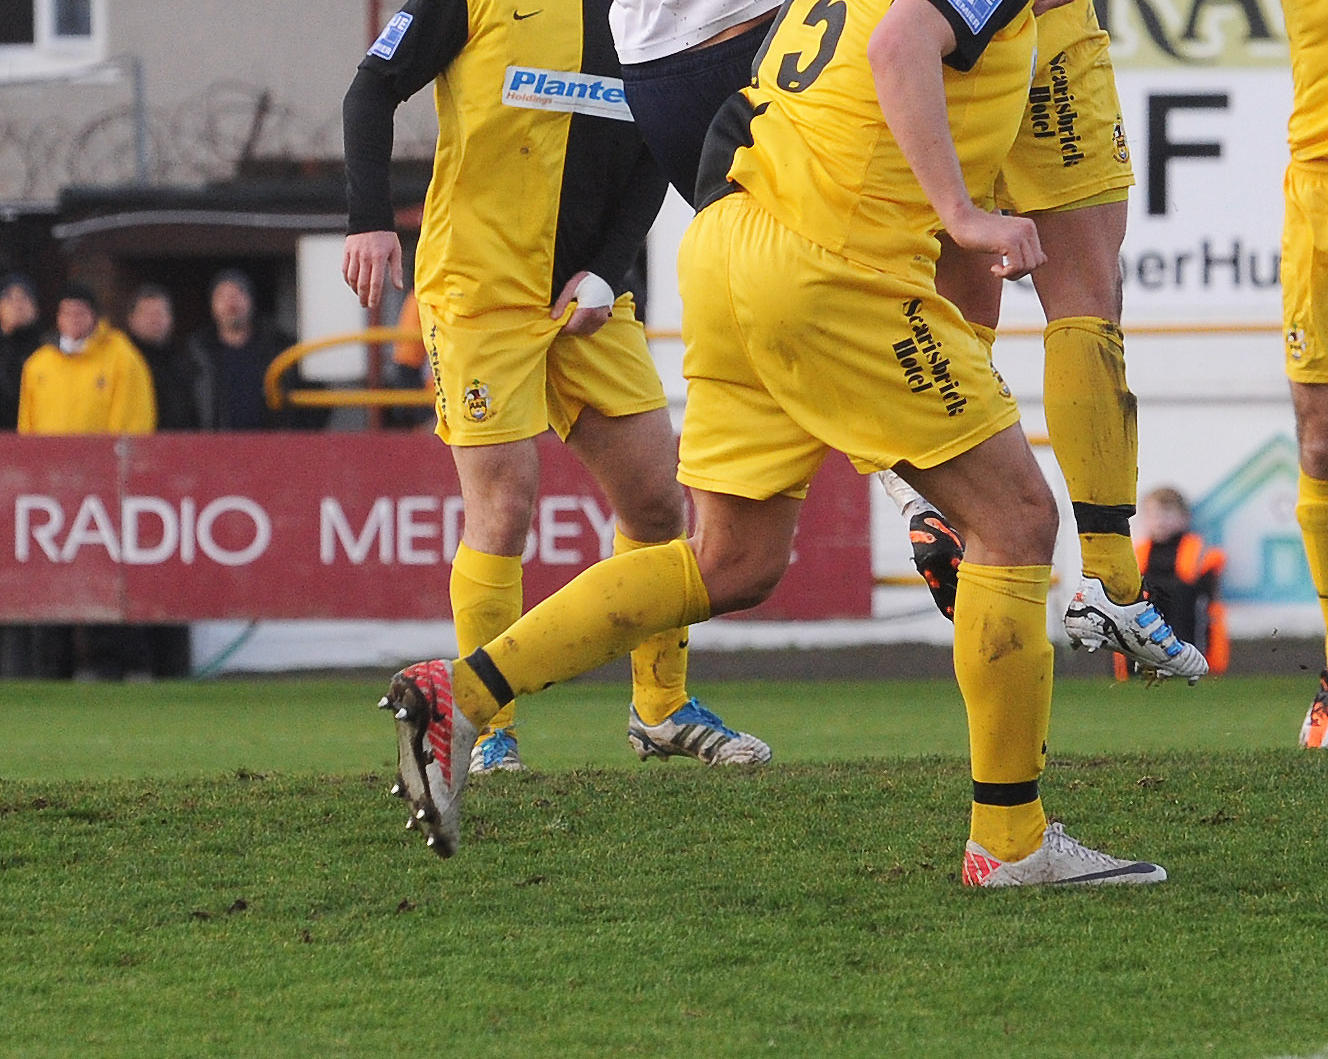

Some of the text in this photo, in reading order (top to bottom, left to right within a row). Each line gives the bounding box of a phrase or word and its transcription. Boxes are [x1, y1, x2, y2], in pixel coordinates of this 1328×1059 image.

[510, 70, 626, 103] Plante
[901, 298, 968, 418] Scarisbrick
[14, 494, 272, 567] RADIO
